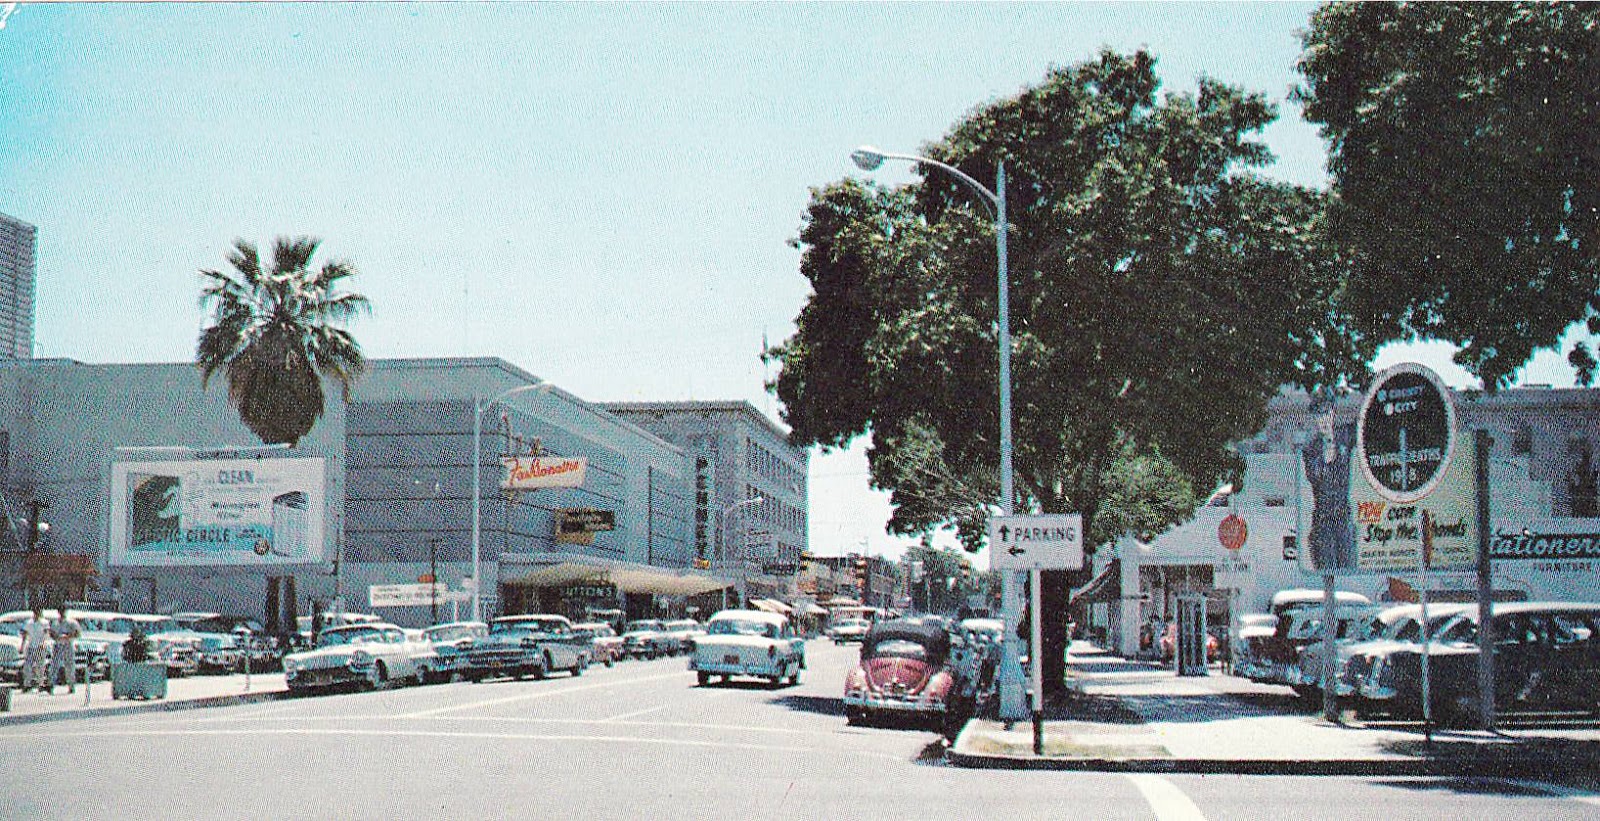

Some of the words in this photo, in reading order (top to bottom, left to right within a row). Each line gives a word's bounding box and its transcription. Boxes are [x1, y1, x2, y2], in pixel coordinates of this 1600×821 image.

[1394, 401, 1418, 413] CITY
[1369, 452, 1405, 467] TRAFFI
[218, 469, 255, 485] CLEAN
[1390, 467, 1417, 484] 198
[1387, 505, 1416, 521] can
[186, 528, 231, 543] CIRCLE
[1014, 527, 1075, 542] PARKING
[1364, 523, 1393, 546] Stop
[1532, 562, 1593, 572] FURNITURE
